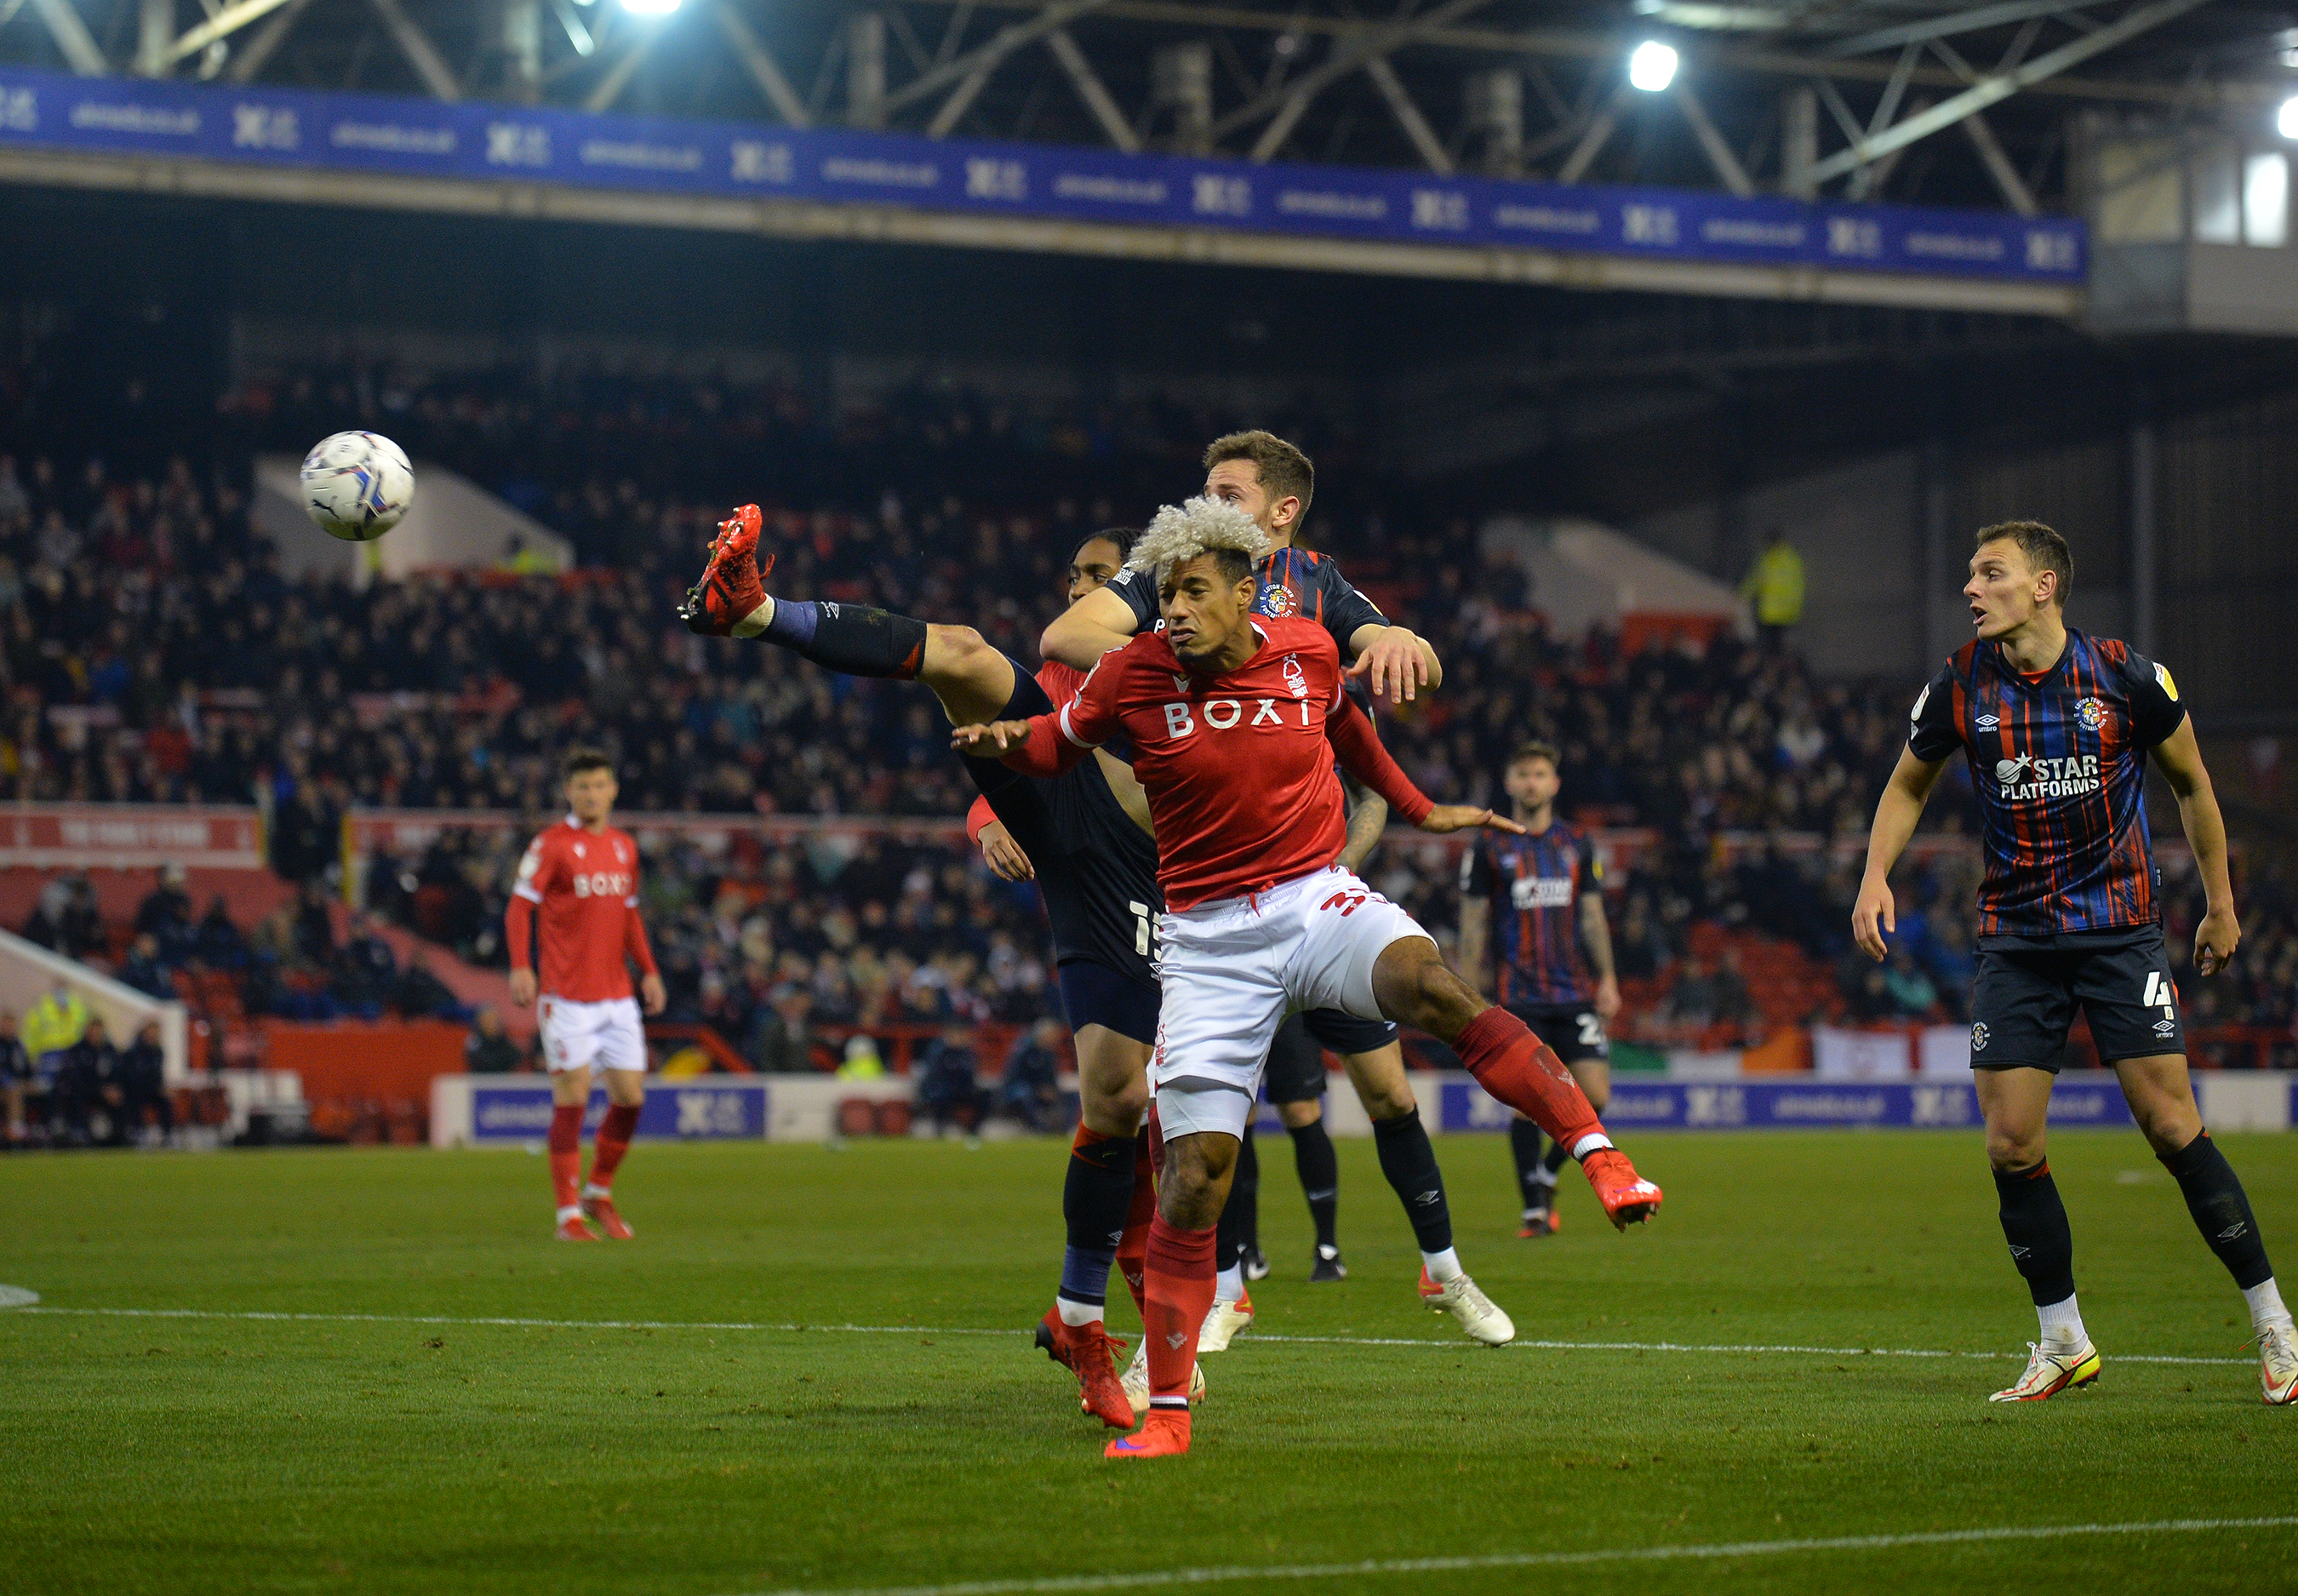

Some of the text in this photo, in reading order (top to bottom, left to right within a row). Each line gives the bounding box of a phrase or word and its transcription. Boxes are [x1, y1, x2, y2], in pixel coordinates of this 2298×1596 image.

[1263, 584, 1295, 598] LUTON TOWN
[1281, 609, 1293, 618] CLUB
[2074, 696, 2104, 710] LUTON TOWN
[2077, 718, 2107, 731] FOOTBALL CLUB
[2033, 755, 2099, 781] STAR
[2001, 775, 2100, 800] PLATFORMS
[2143, 971, 2175, 1021] 4
[1575, 1013, 1605, 1045] 2
